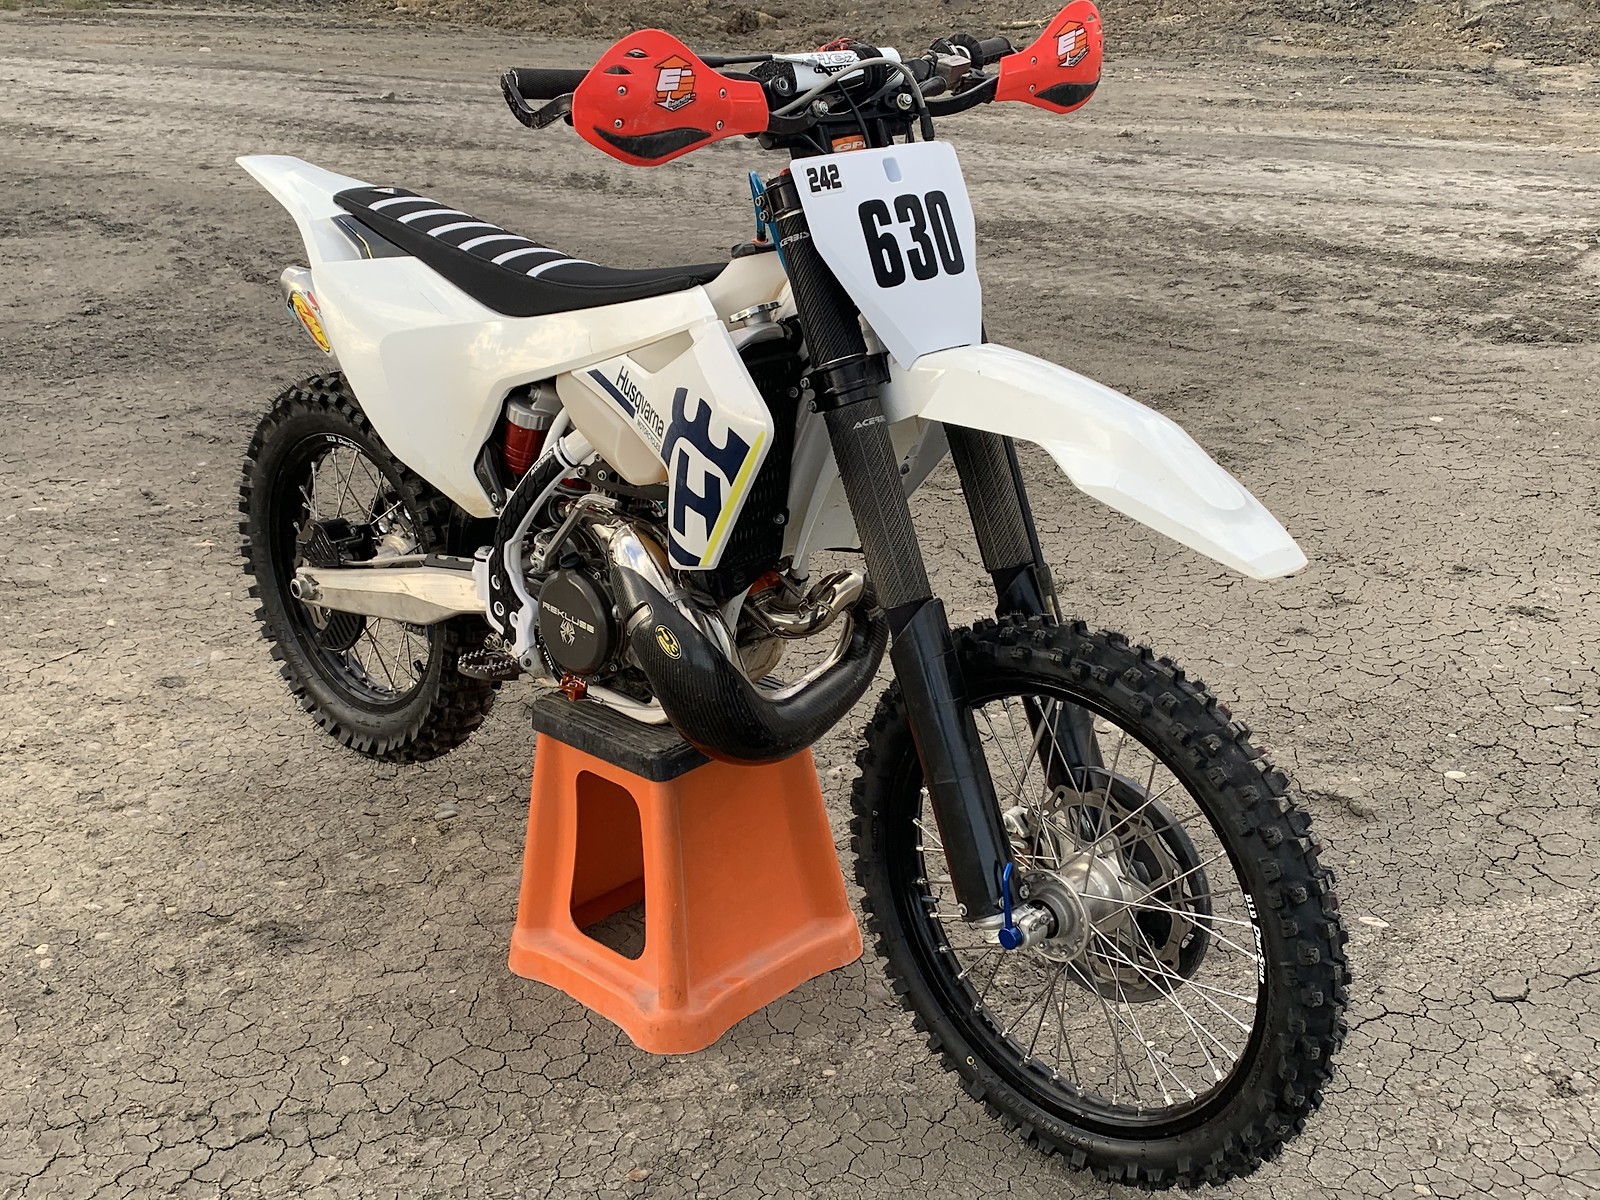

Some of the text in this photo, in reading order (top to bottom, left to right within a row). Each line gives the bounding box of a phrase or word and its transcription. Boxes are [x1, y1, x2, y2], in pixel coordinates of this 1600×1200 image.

[806, 163, 842, 193] 242
[858, 190, 965, 288] 630
[616, 365, 664, 439] Husqvarna
[542, 601, 595, 634] REKLUSE
